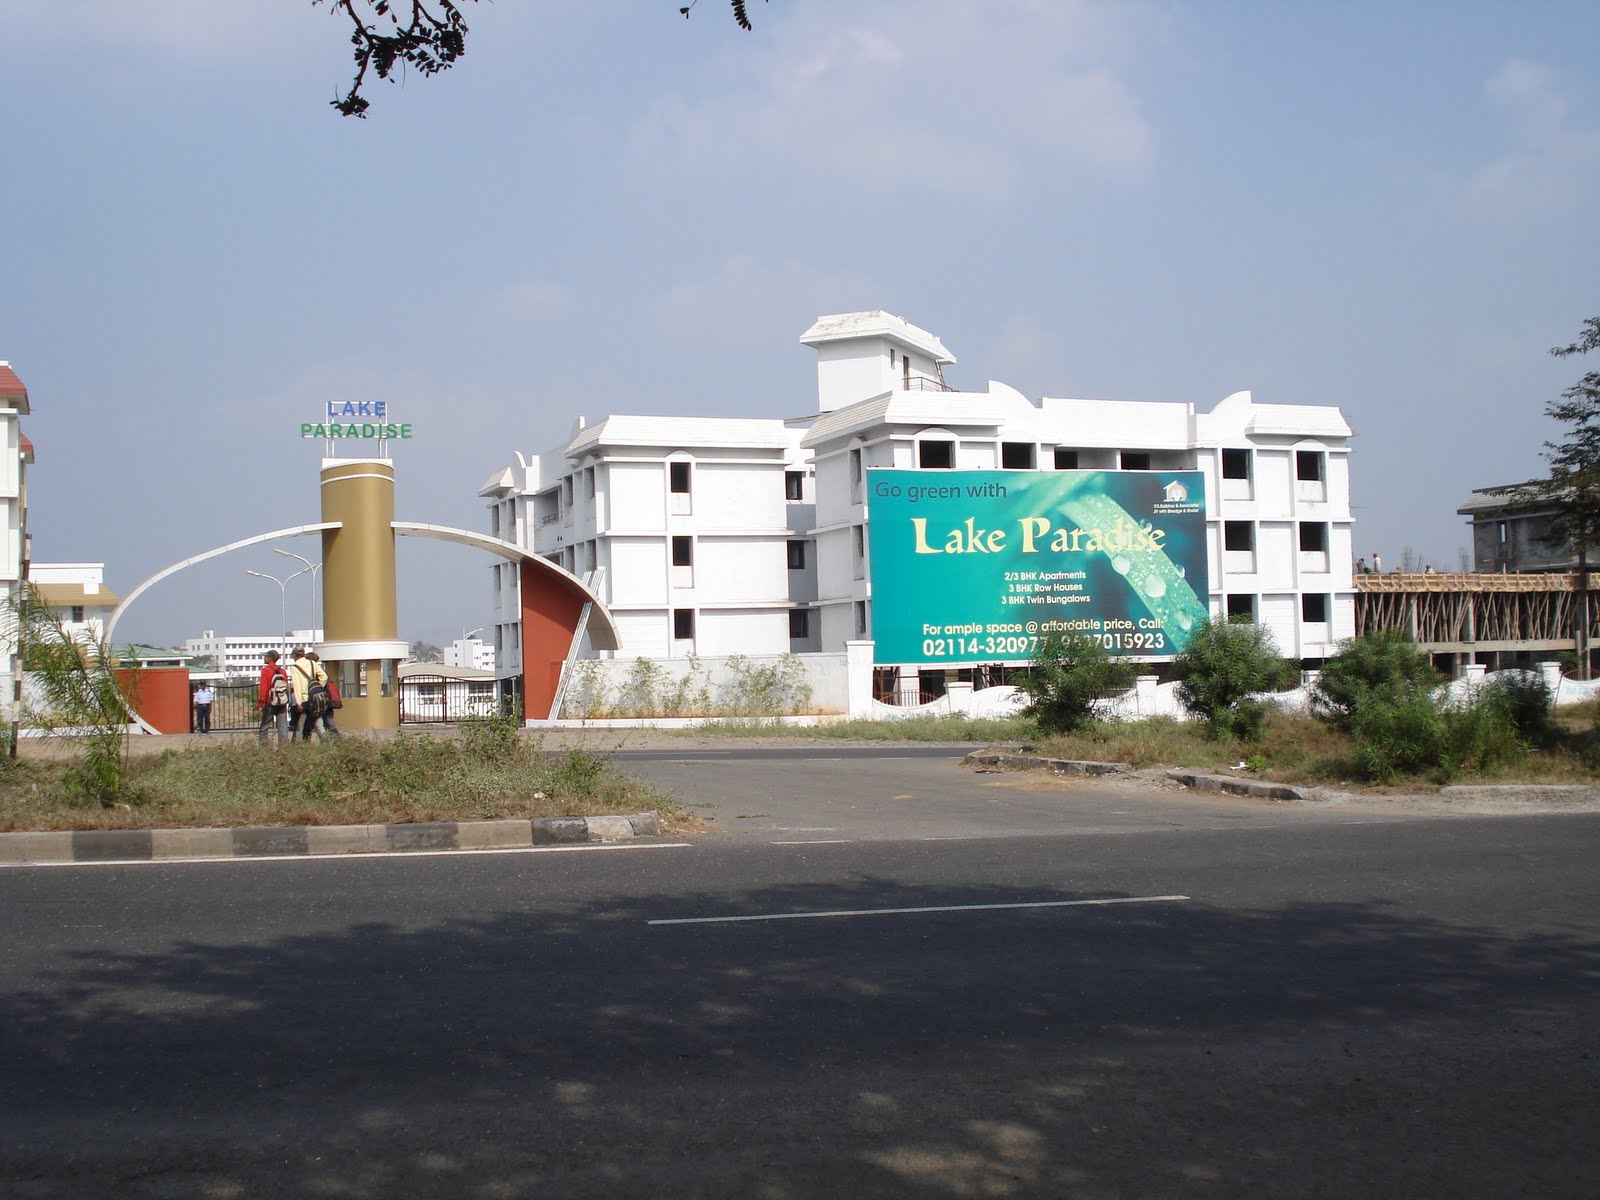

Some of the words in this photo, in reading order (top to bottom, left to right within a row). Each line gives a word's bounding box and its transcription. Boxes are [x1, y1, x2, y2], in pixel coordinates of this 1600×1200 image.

[328, 400, 386, 416] LAKE
[301, 423, 412, 439] PARADISE
[875, 481, 902, 498] Go
[907, 485, 961, 503] green
[966, 482, 1007, 498] with
[911, 516, 1007, 554] Lake
[1018, 516, 1166, 553] Paradise
[1004, 572, 1018, 581] 2/3
[1020, 571, 1037, 581] BHK
[1038, 570, 1086, 581] Apartments
[1008, 584, 1014, 593] 3
[1016, 584, 1033, 593] BHK
[1034, 583, 1051, 592] Row
[1053, 583, 1083, 592] Houses
[1001, 596, 1007, 605] 3
[1008, 596, 1025, 605] BHK
[1026, 595, 1045, 604] Twin
[1046, 594, 1091, 605] Bungalows
[923, 623, 941, 635] For
[944, 622, 983, 636] ample
[986, 623, 1022, 635] space
[1025, 621, 1038, 634] @
[1041, 619, 1101, 632] affordable
[1103, 618, 1135, 631] price,
[1138, 617, 1164, 629] Call:
